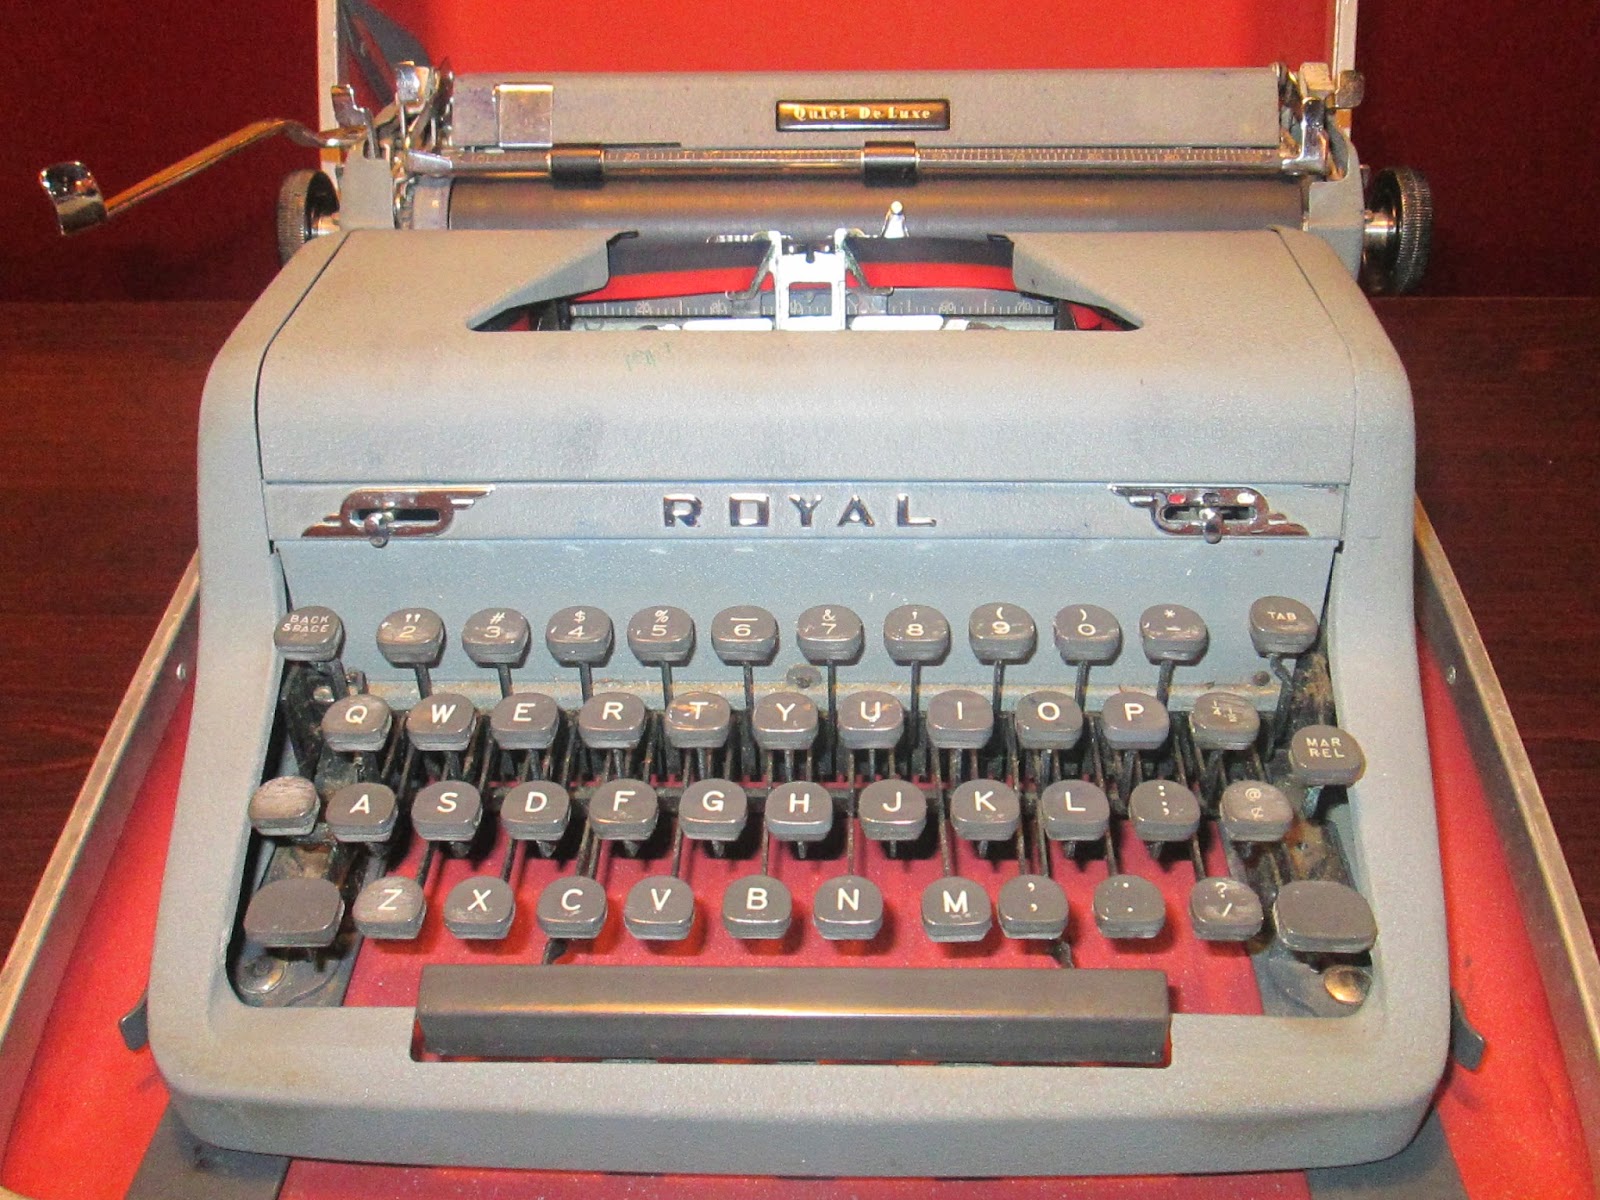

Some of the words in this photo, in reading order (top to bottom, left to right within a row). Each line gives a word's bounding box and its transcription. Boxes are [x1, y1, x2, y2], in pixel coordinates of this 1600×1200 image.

[793, 106, 848, 120] Quiet
[663, 492, 937, 527] ROYAL
[289, 615, 328, 623] BACK
[490, 613, 505, 624] #
[574, 610, 585, 622] $
[655, 610, 668, 622] %
[823, 609, 835, 621] &
[997, 607, 1003, 619] (
[1080, 609, 1086, 620] )
[1268, 612, 1296, 620] TAB
[282, 623, 329, 632] SPACE
[399, 626, 416, 637] 2
[485, 626, 503, 637] 3
[568, 626, 584, 637] 4
[652, 625, 667, 636] 5
[734, 624, 750, 636] 6
[821, 623, 836, 634] 7
[907, 624, 924, 635] 8
[993, 622, 1010, 633] 9
[1078, 624, 1096, 635] 0
[346, 705, 367, 723] Q
[432, 704, 456, 723] W
[514, 703, 535, 721] E
[603, 702, 623, 719] R
[689, 702, 708, 719] T
[776, 703, 795, 721] Y
[861, 702, 880, 721] U
[957, 701, 962, 719] I
[1038, 702, 1060, 720] O
[1125, 703, 1144, 720] P
[1307, 737, 1341, 746] MAR
[1309, 748, 1344, 757] REL
[437, 792, 458, 812] S
[525, 792, 547, 812] D
[614, 791, 635, 811] F
[703, 791, 724, 811] G
[790, 793, 809, 813] H
[883, 792, 901, 812] J
[975, 791, 996, 811] K
[1065, 792, 1086, 811] L
[1245, 788, 1262, 801] @
[350, 794, 369, 813] A
[1216, 882, 1228, 897] ?
[378, 889, 400, 910] Z
[468, 889, 491, 911] X
[562, 889, 583, 911] C
[651, 889, 671, 910] V
[747, 888, 767, 909] B
[838, 888, 859, 910] N
[944, 891, 967, 913] M
[1223, 903, 1232, 916] /
